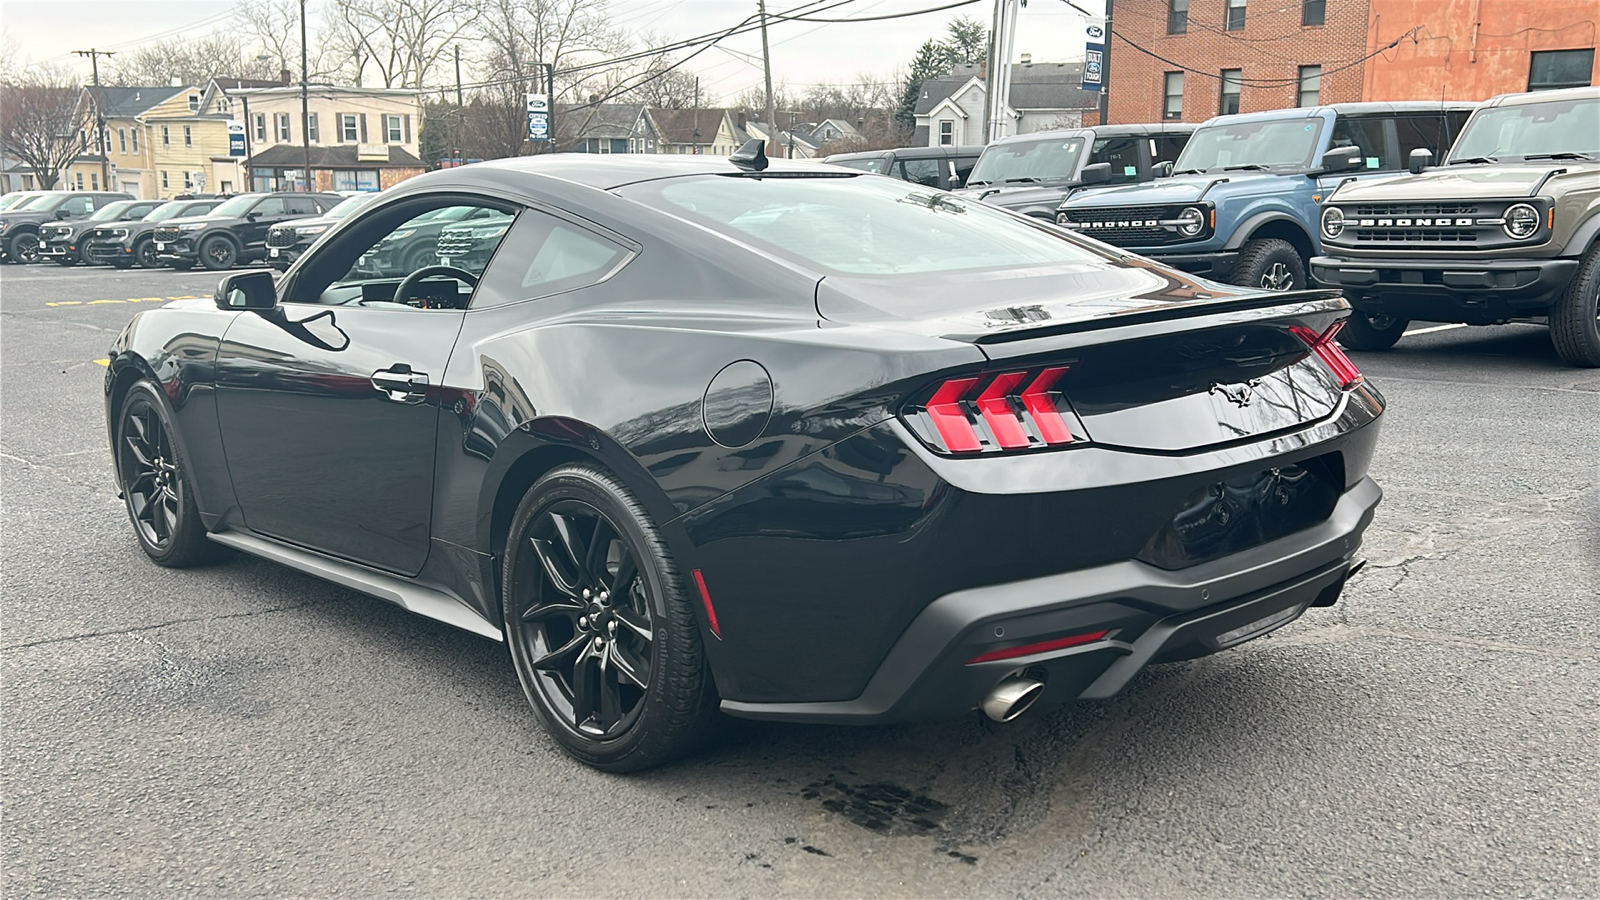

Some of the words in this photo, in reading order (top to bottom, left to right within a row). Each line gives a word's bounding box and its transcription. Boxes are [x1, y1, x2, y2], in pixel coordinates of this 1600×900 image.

[1088, 26, 1102, 37] Ford
[1088, 53, 1102, 63] BUILT
[1086, 72, 1100, 81] TOUGH
[1080, 220, 1158, 228] BRONCO
[1360, 218, 1472, 228] BRONCO
[657, 627, 668, 695] Continental
